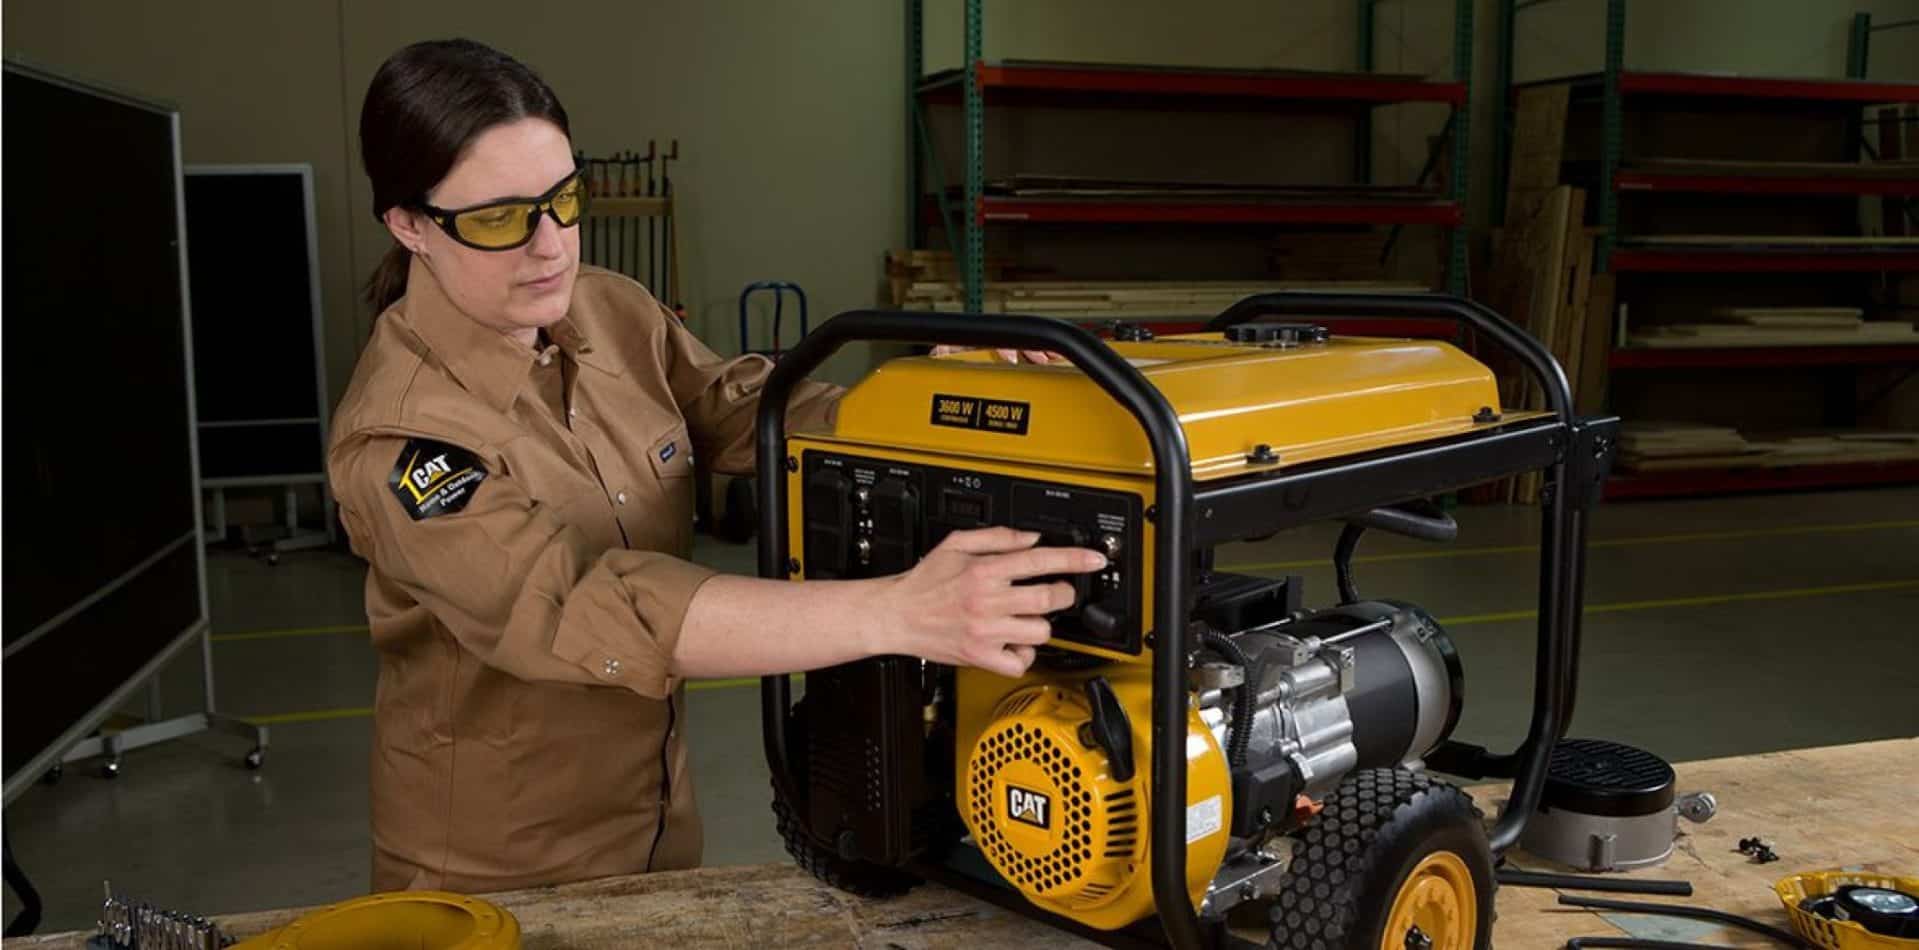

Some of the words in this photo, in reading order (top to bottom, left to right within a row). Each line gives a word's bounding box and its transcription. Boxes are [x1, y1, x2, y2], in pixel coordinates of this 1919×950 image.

[938, 400, 960, 414] 3600
[962, 401, 974, 415] W
[985, 404, 1009, 419] 4500
[1010, 406, 1023, 421] W
[412, 454, 451, 489] CAT
[440, 487, 465, 506] Power
[1010, 788, 1047, 824] CAT
